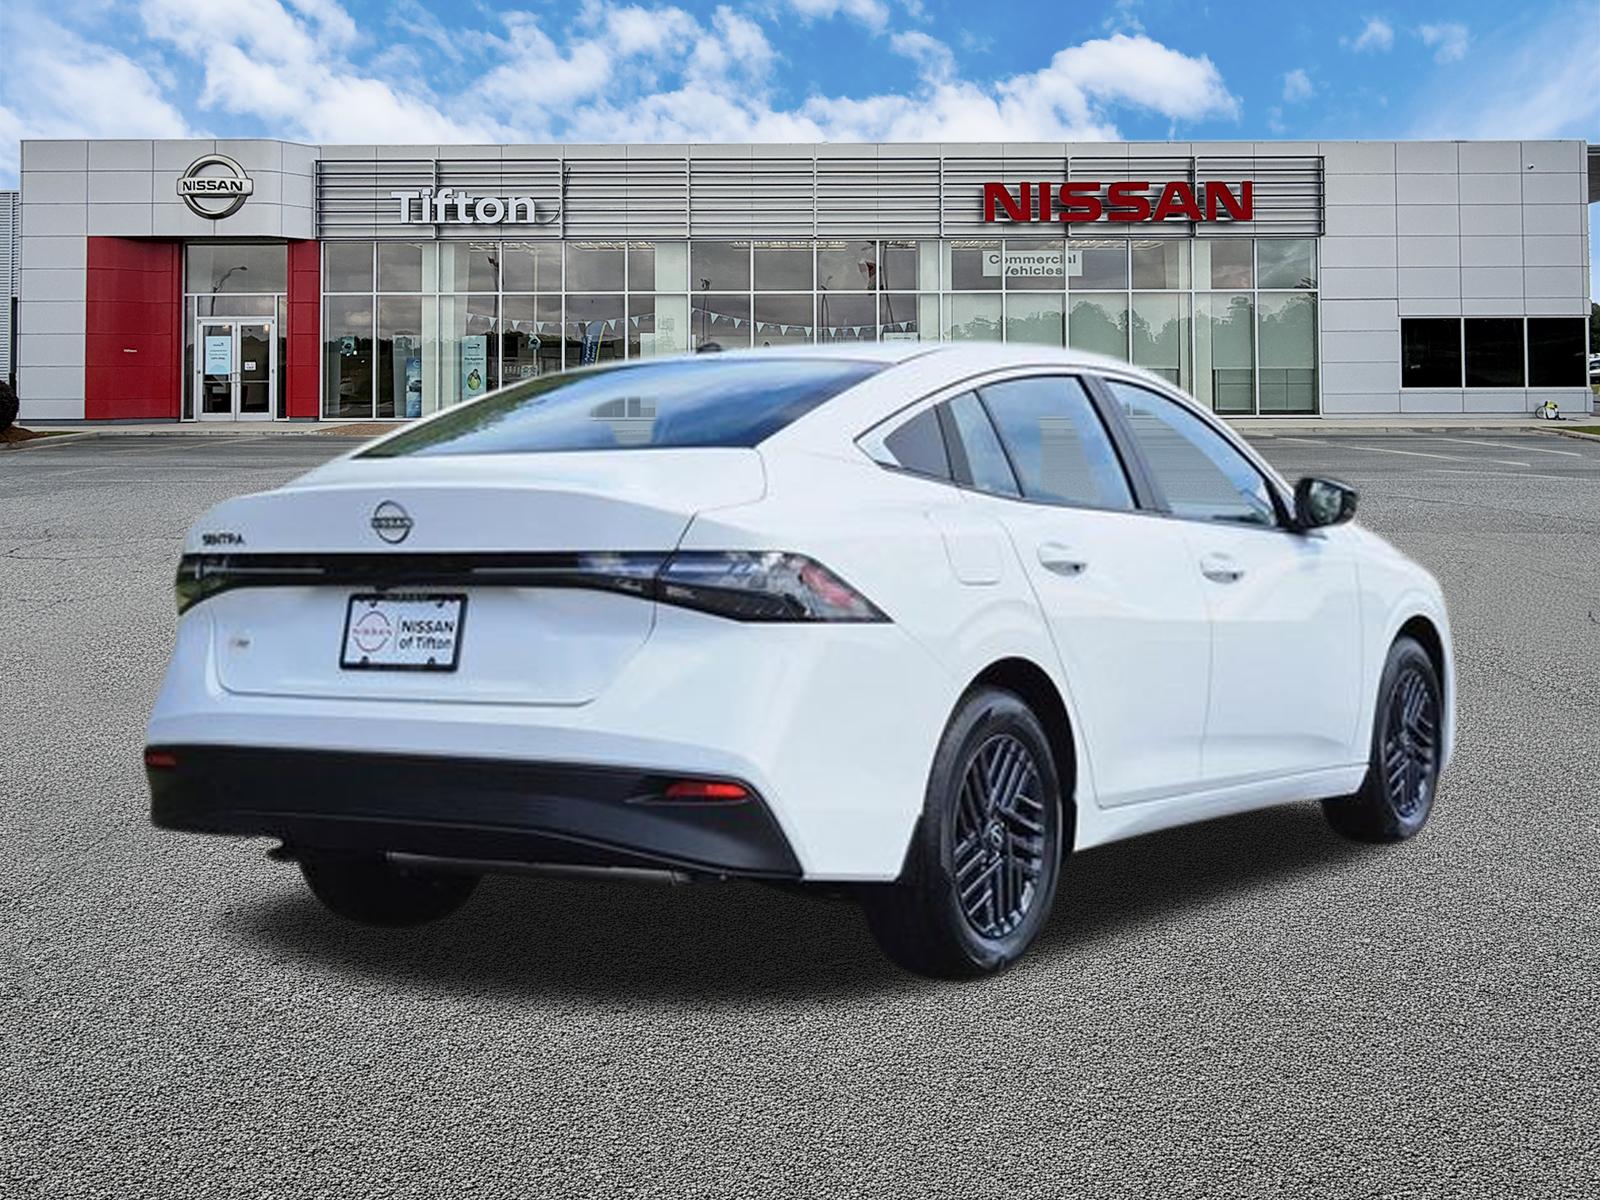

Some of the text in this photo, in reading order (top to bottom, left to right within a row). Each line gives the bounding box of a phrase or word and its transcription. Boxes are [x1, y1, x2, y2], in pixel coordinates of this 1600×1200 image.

[182, 180, 243, 192] NISSAN
[391, 187, 537, 224] Tifton
[983, 181, 1254, 223] NISSAN
[401, 620, 455, 634] NISSAN
[399, 636, 452, 650] of Tifton
